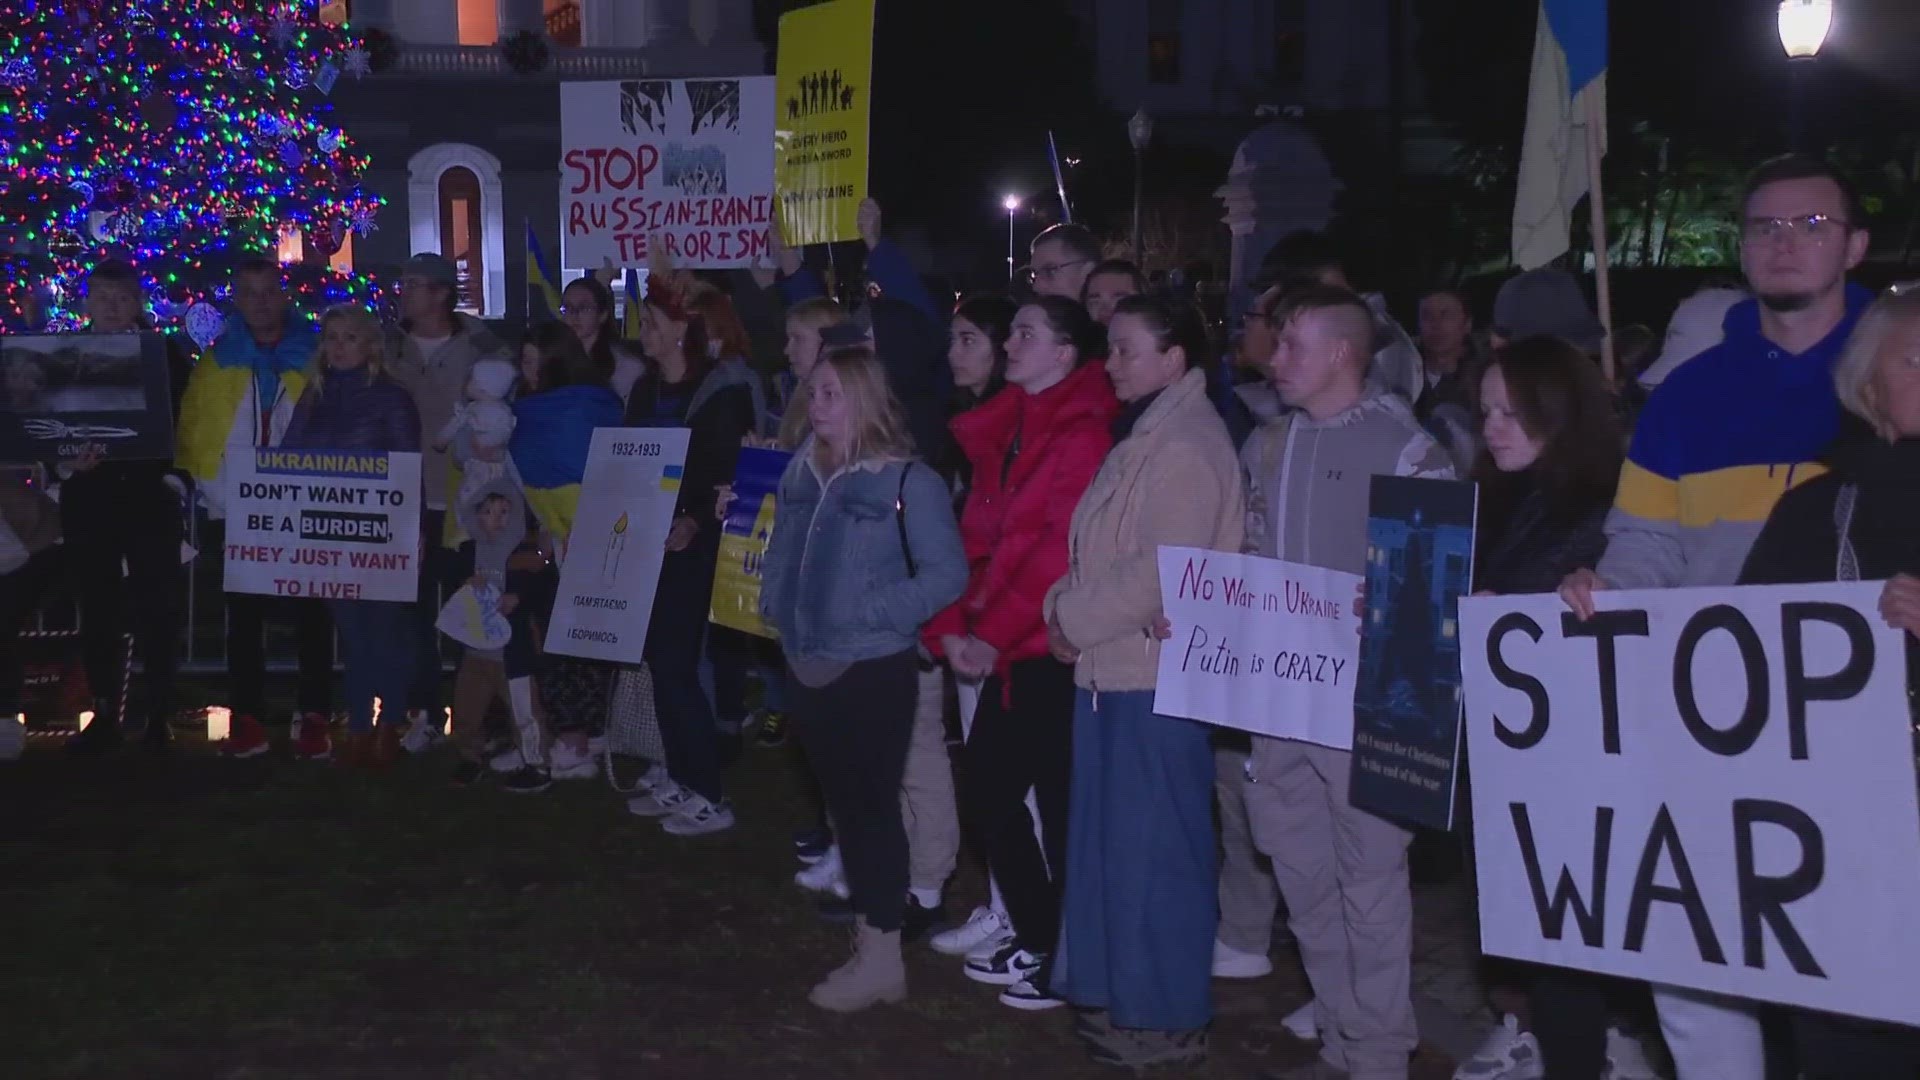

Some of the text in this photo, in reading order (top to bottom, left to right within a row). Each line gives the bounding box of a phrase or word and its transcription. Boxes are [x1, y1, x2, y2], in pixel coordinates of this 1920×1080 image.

[821, 130, 847, 144] HERO
[820, 148, 852, 161] SWORD
[564, 144, 658, 195] STOP
[613, 229, 771, 262] TERORISM
[257, 450, 388, 475] UKRAINIANS
[612, 443, 661, 456] 1932-1933
[240, 483, 404, 506] DON'T WANT TO
[248, 514, 393, 541] BE A BURDEN,
[228, 545, 409, 571] THEY JUST WANT
[274, 579, 361, 599] TO LIVE!
[1179, 557, 1213, 600] No
[1223, 577, 1255, 608] War
[1263, 593, 1278, 613] in
[571, 629, 618, 643] БОРИМОСЬ
[1182, 625, 1346, 686] Putin is CRAZY
[1486, 601, 1876, 760] STOP
[1509, 798, 1829, 979] WAR
